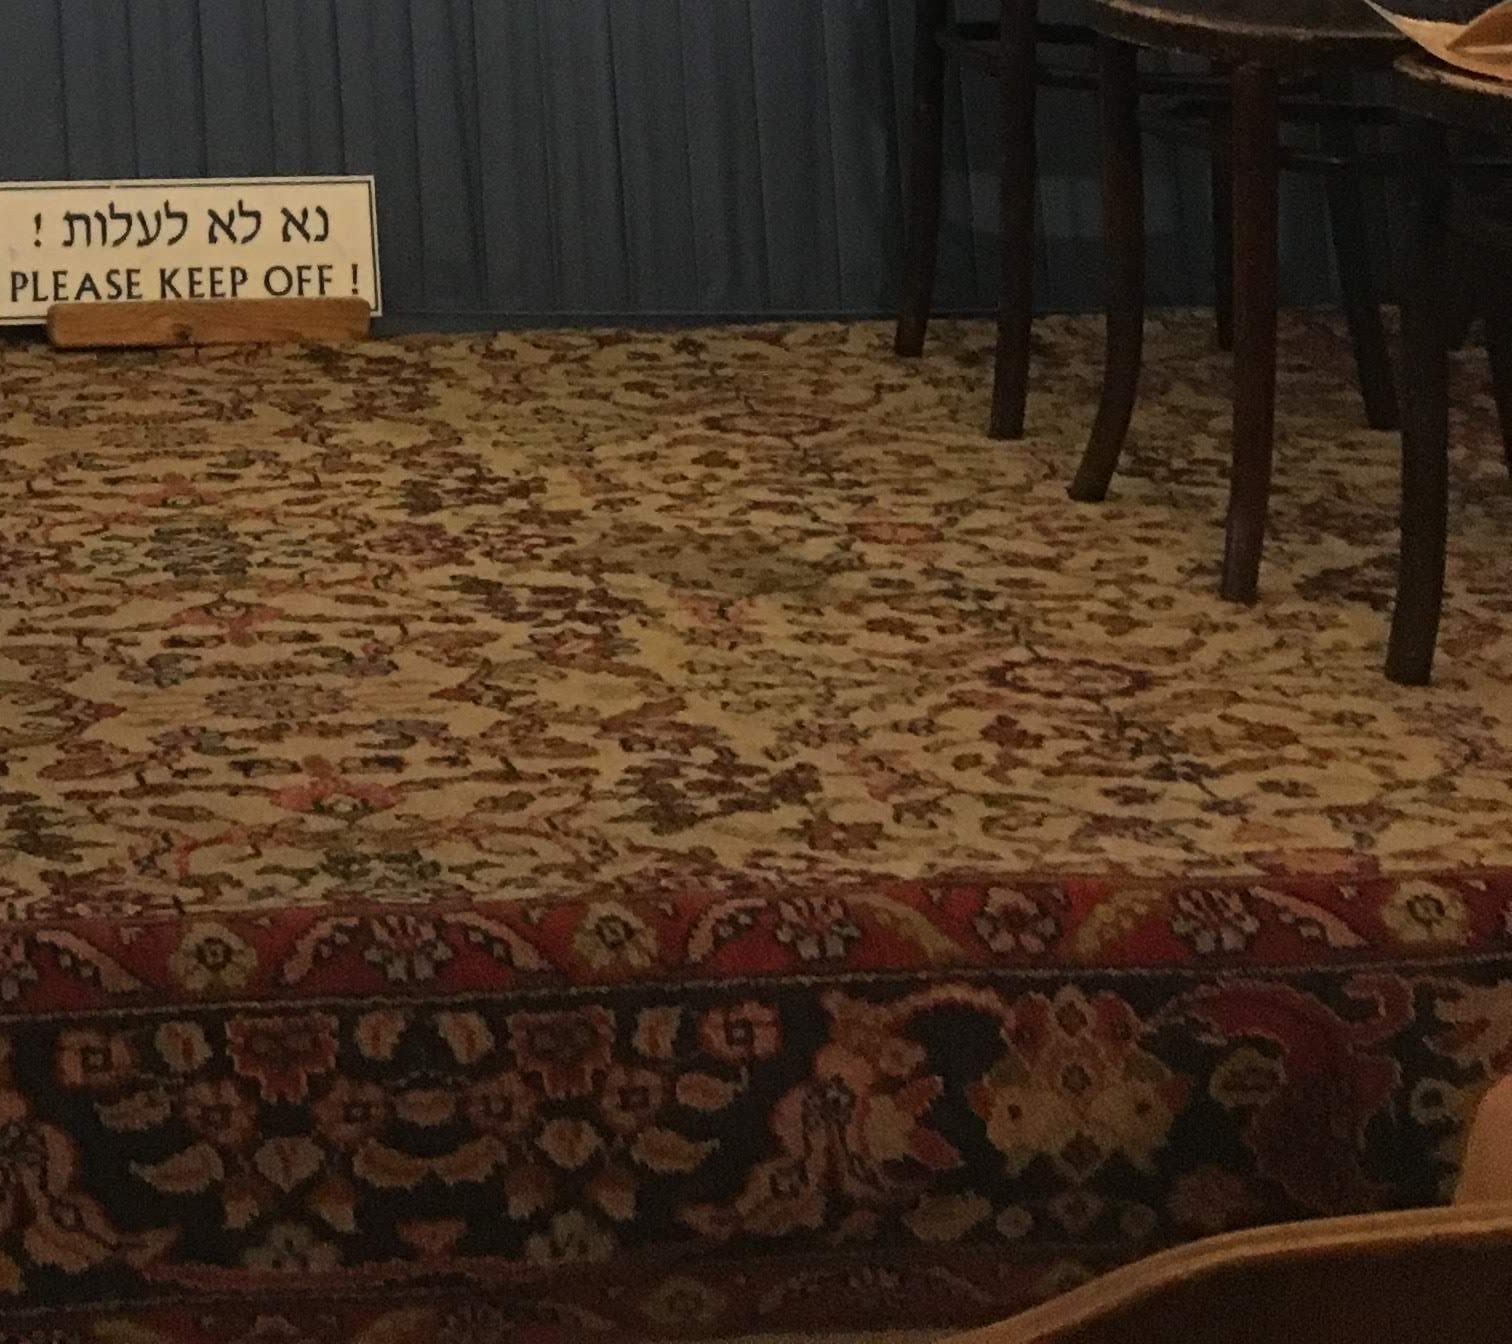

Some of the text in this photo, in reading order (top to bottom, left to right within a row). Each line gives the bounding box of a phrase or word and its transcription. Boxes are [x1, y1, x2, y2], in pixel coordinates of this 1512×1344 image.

[62, 199, 188, 247] לעלות
[207, 199, 262, 245] לא
[281, 204, 329, 245] נא
[10, 267, 143, 302] PLEASE
[159, 265, 249, 300] KEEP
[263, 263, 333, 296] OFF
